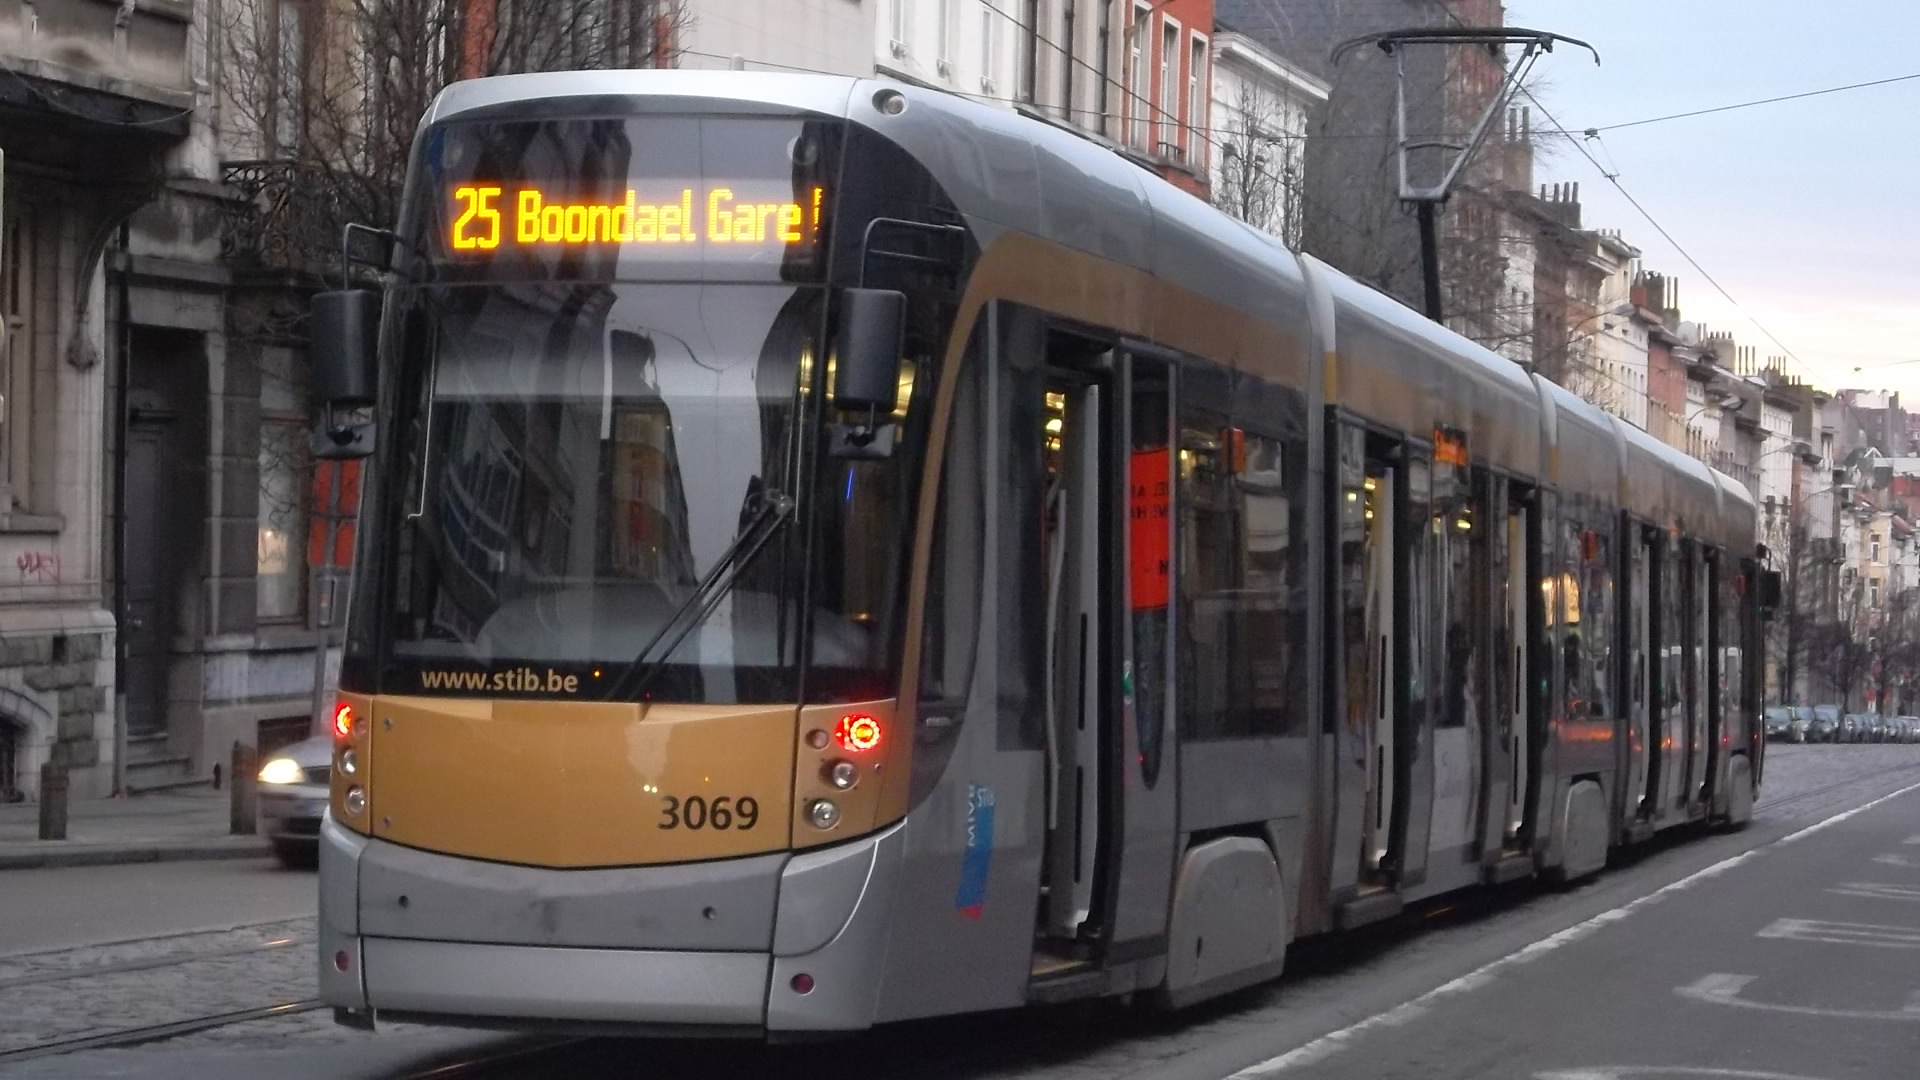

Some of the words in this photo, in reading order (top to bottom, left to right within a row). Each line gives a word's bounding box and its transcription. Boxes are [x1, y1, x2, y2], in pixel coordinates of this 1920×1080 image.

[453, 187, 501, 248] 25
[517, 188, 697, 242] Boondael
[708, 188, 802, 242] Gare
[420, 667, 579, 693] www.stib.be
[657, 795, 759, 831] 3069
